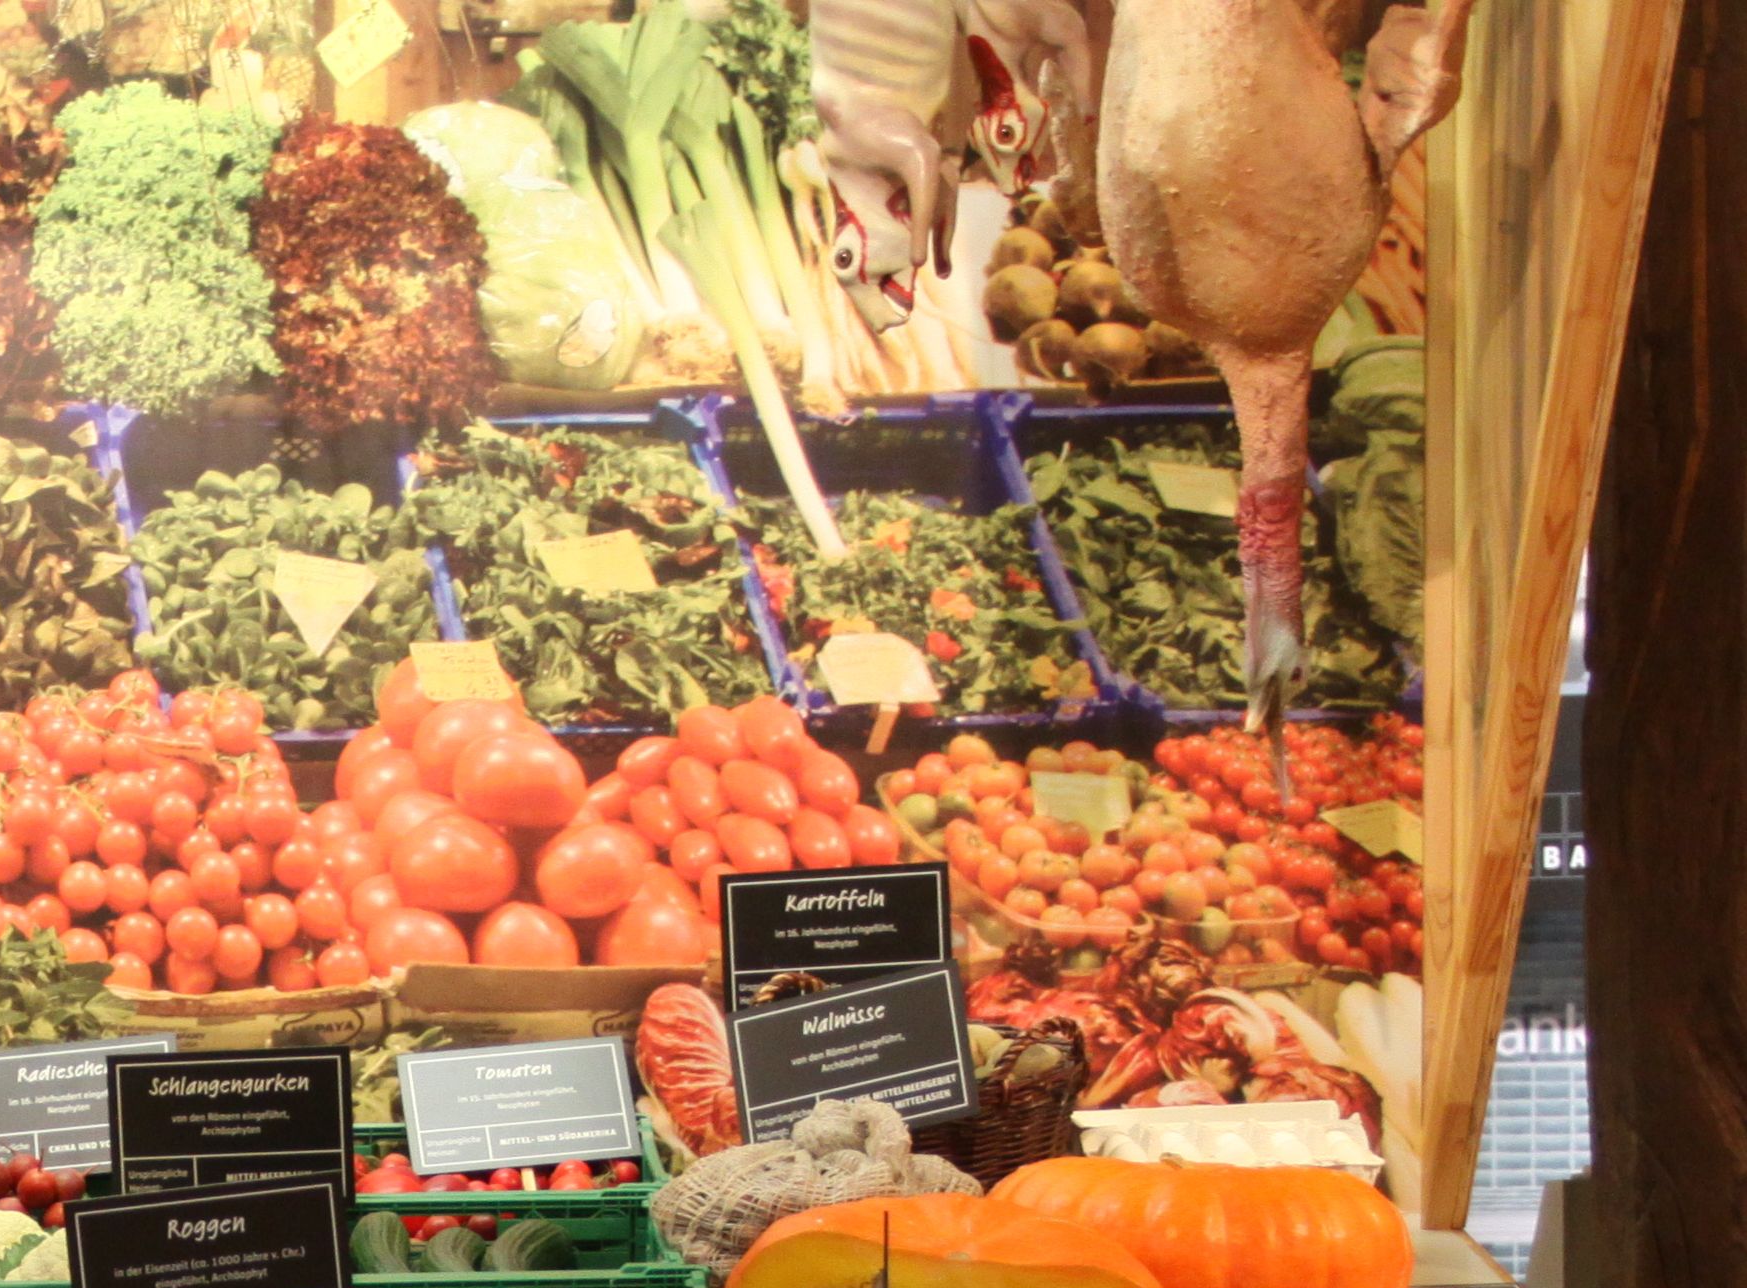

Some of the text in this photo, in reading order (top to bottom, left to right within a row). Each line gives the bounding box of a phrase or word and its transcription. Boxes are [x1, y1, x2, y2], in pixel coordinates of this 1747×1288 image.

[785, 888, 885, 912] Kartoffeln
[801, 925, 850, 937] Jahrhundert
[852, 923, 897, 935] eingeführt,
[814, 939, 859, 950] Neophyten
[803, 1004, 885, 1035] Walnüsse
[475, 1063, 552, 1080] Tomaten
[148, 1073, 309, 1098] Schlangengurken
[872, 1073, 956, 1100] MITTELMEERGEBIET
[35, 1092, 82, 1104] Jahrhundert
[893, 1089, 952, 1109] MITTELASIEN
[47, 1104, 91, 1114] Neophyten
[242, 1109, 290, 1122] eingeführt,
[499, 1128, 617, 1146] MITTEL- UND SÜDAMERIKA
[48, 1144, 76, 1153] CHINA
[78, 1142, 97, 1151] UND
[128, 1169, 188, 1180] Ursprüngliche
[167, 1216, 246, 1242] Roggen
[113, 1267, 124, 1278] in
[126, 1265, 142, 1276] der
[145, 1260, 188, 1274] Eisenzeit
[190, 1257, 209, 1271] (ca.
[243, 1251, 268, 1263] Jahre
[271, 1251, 280, 1260] v.
[281, 1246, 305, 1259] Chr.)
